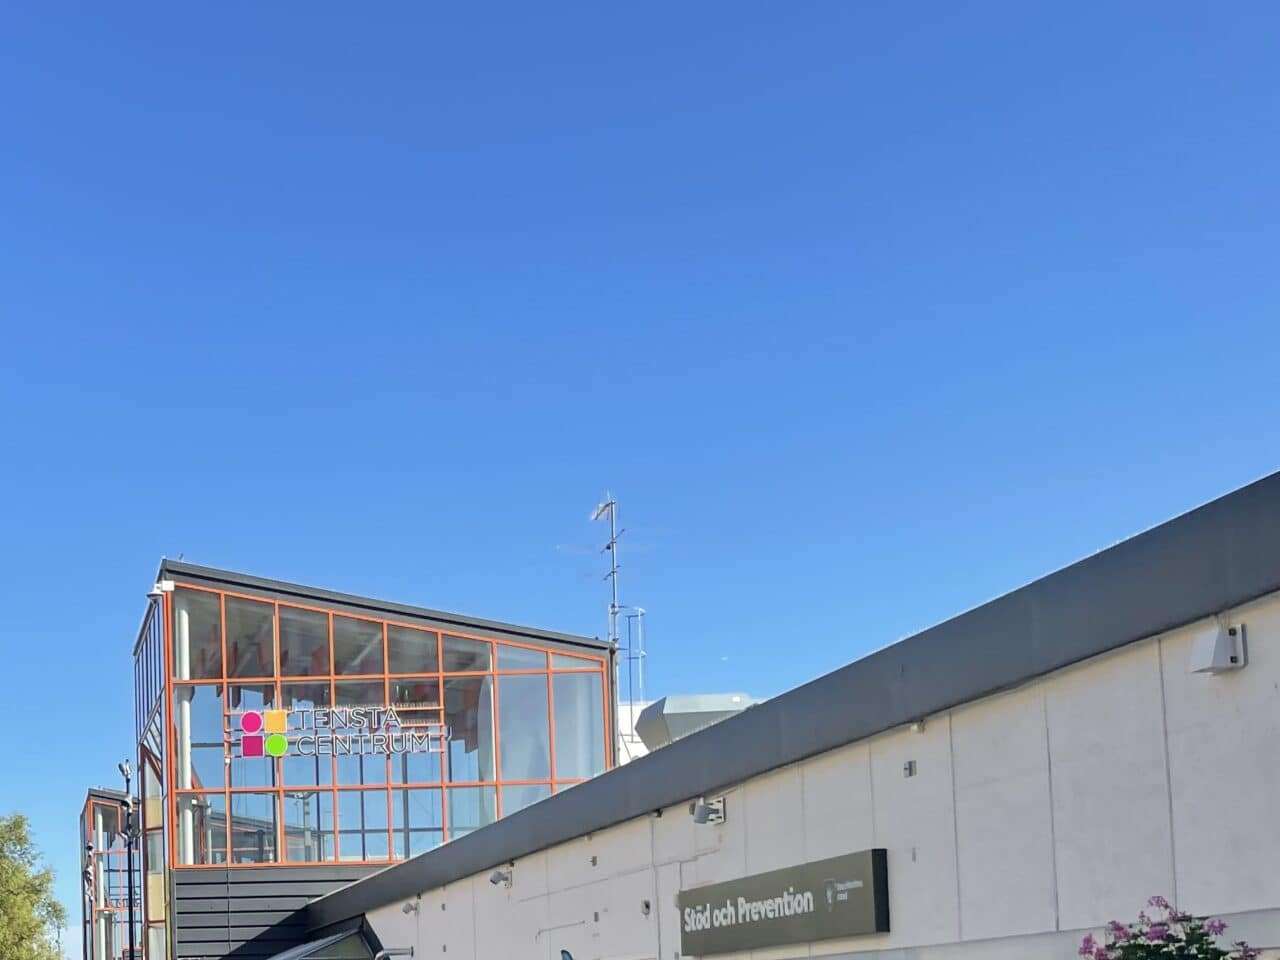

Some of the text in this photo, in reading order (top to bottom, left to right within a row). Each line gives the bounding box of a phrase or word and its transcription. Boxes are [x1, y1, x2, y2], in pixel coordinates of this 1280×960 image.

[296, 707, 401, 730] TENSTA
[296, 732, 432, 756] CENTRUM
[684, 886, 814, 932] Stöd och Prevention
